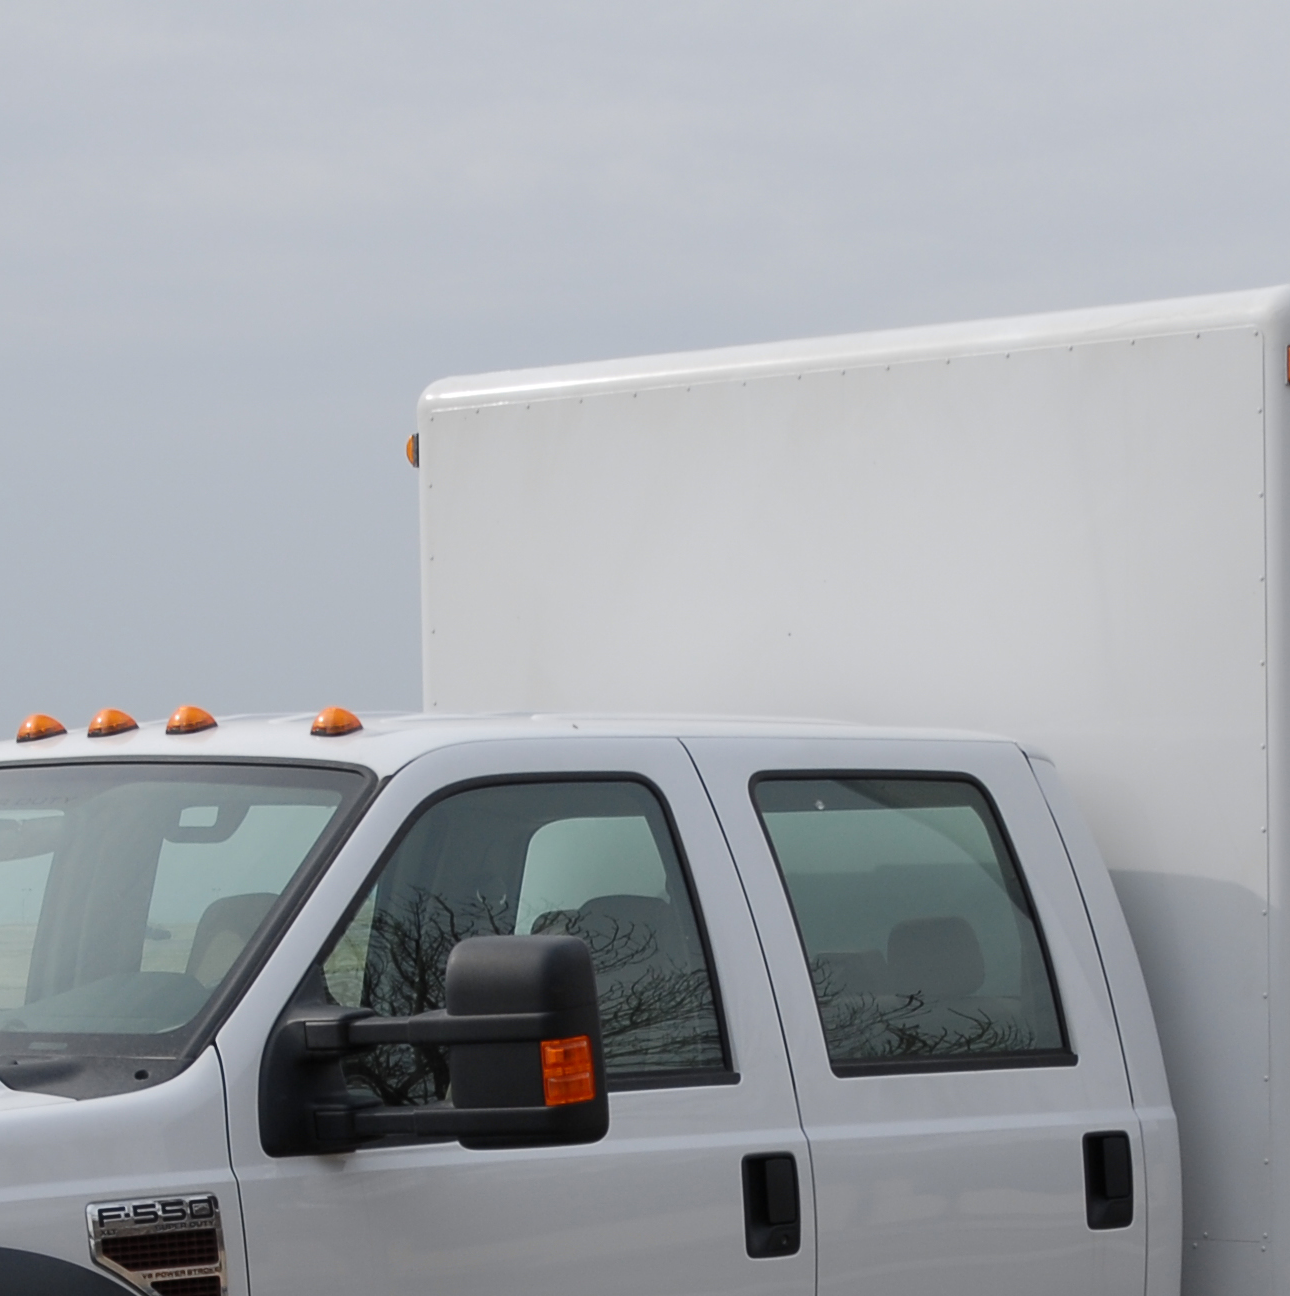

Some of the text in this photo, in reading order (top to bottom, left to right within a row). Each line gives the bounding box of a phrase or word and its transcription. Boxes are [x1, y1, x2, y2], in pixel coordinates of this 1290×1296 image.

[15, 796, 78, 807] DUTY
[100, 1220, 215, 1237] XLT SUPER DUTY
[155, 1269, 186, 1279] POWER
